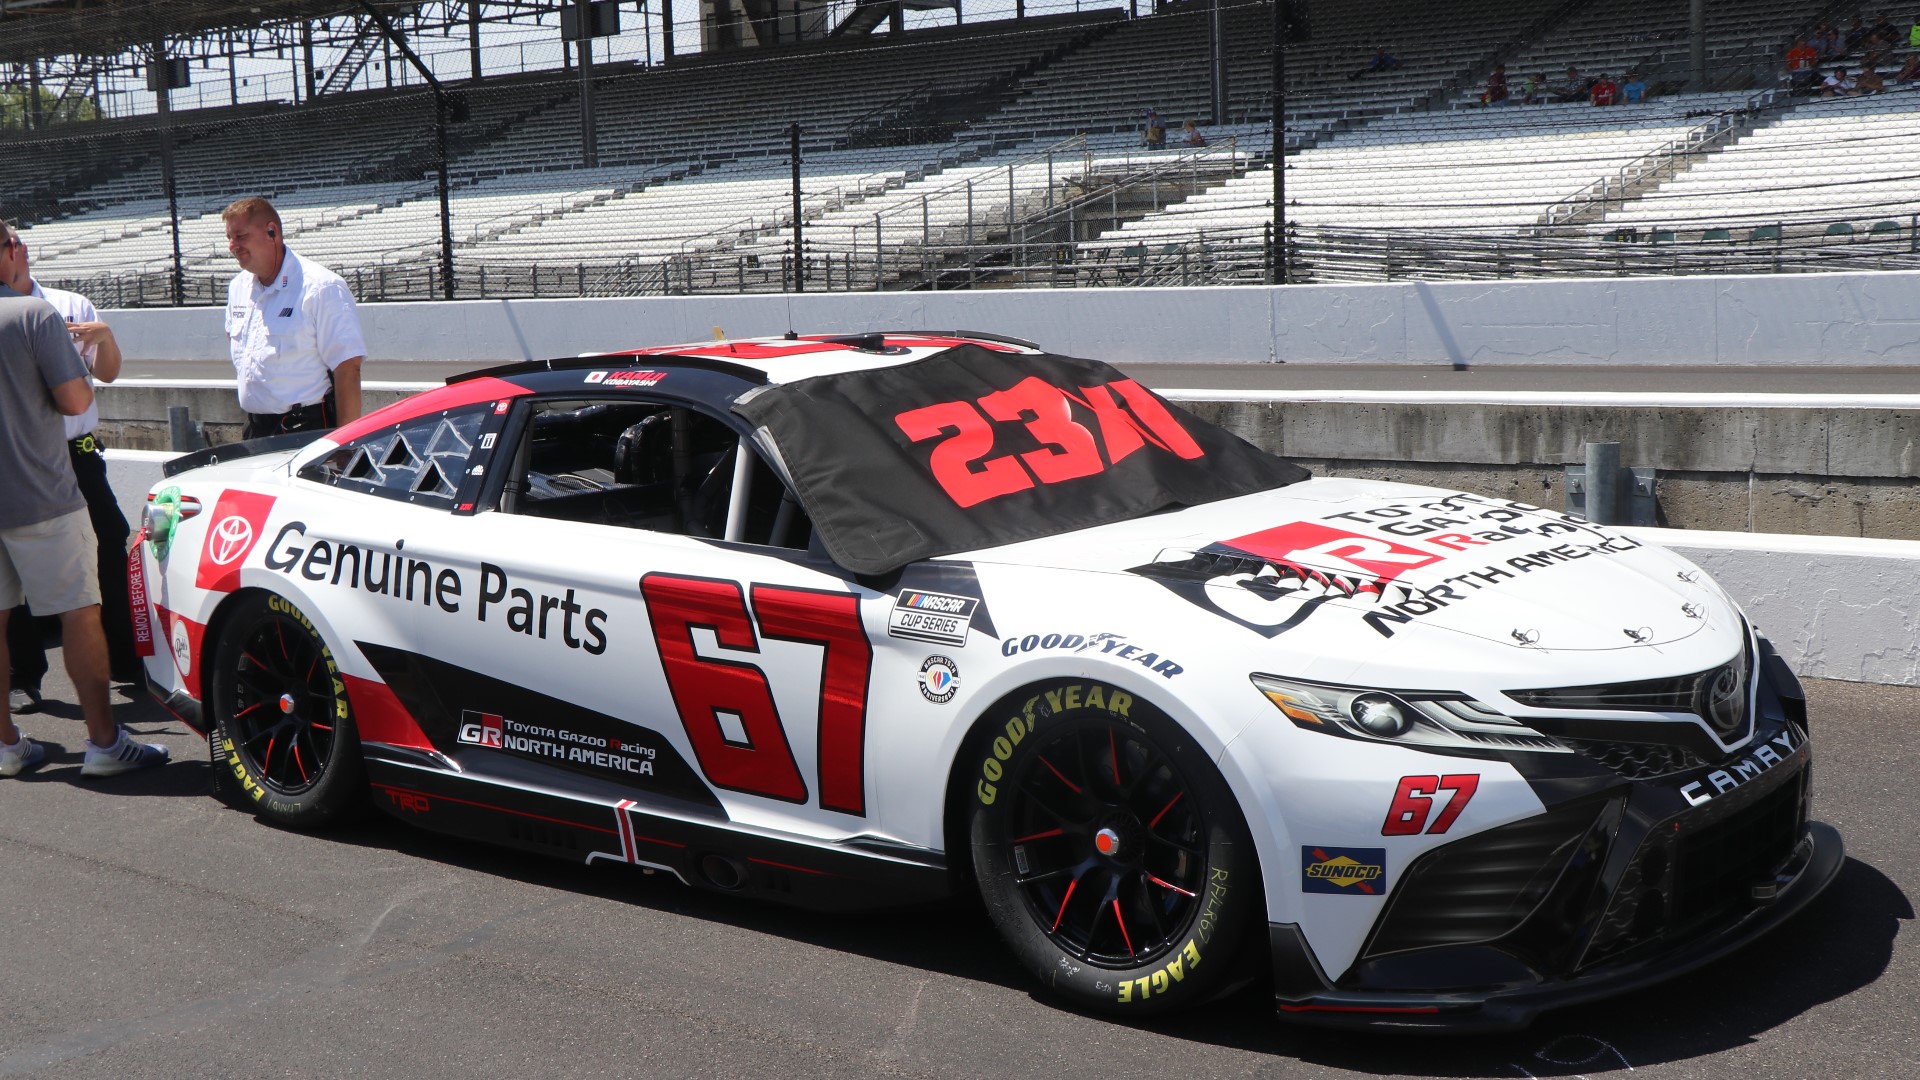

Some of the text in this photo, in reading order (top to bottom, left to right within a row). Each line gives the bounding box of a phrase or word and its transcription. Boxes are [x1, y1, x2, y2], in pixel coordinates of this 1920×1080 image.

[602, 379, 657, 387] KOBAYASHI
[130, 547, 150, 642] REMOVE BEFORE FLIGH
[264, 520, 609, 656] Genuine Parts
[919, 595, 966, 613] NASCAR
[1362, 566, 1515, 638] NORTH
[901, 614, 958, 633] CUP SERIES
[924, 656, 943, 670] NASCAR
[639, 572, 873, 817] 67
[460, 723, 501, 746] GR
[504, 719, 656, 760] TOYOTA GAZOO Racing
[221, 737, 265, 802] EAGLE
[504, 735, 654, 776] NORTH AMERICA
[1381, 773, 1481, 837] 67
[1308, 864, 1379, 879] SUNOCO
[1118, 939, 1202, 1003] EAGLE
